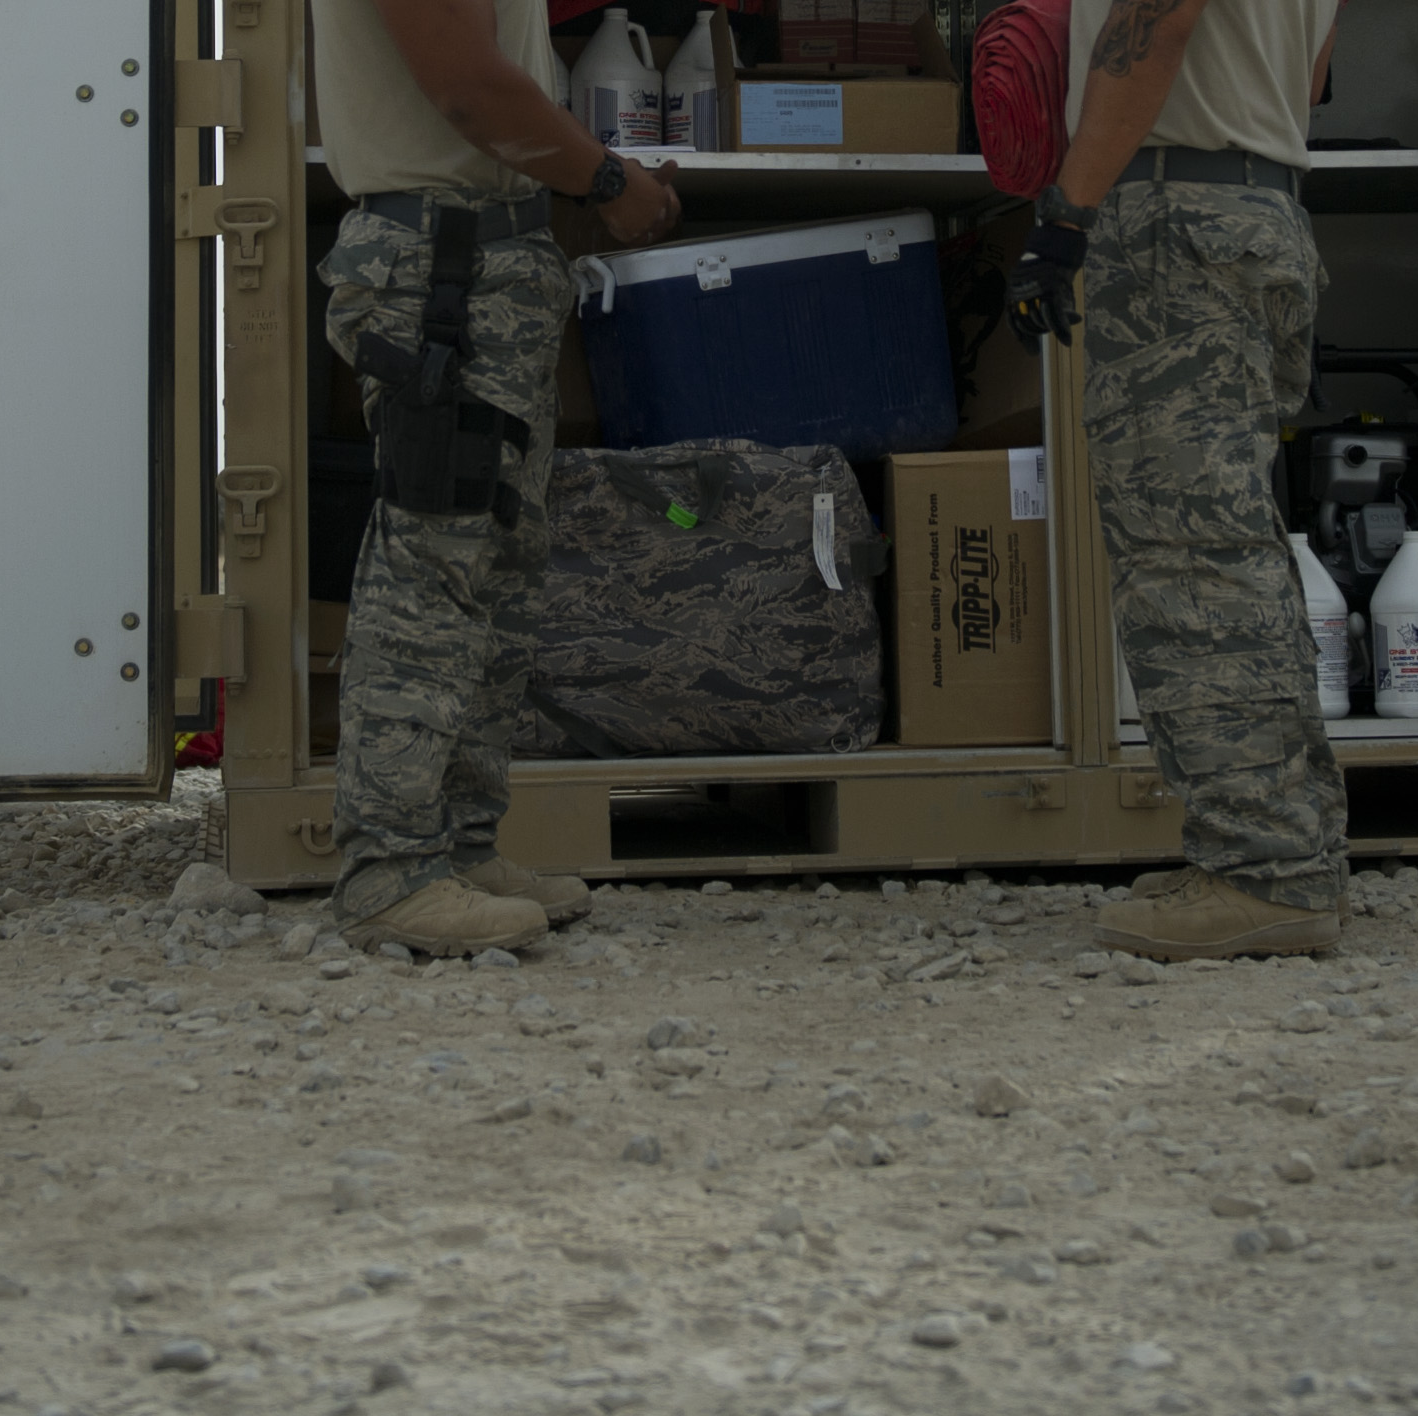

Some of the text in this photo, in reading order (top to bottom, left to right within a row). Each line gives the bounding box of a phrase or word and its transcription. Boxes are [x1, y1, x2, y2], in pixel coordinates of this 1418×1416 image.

[928, 493, 943, 688] Another Quality Product From
